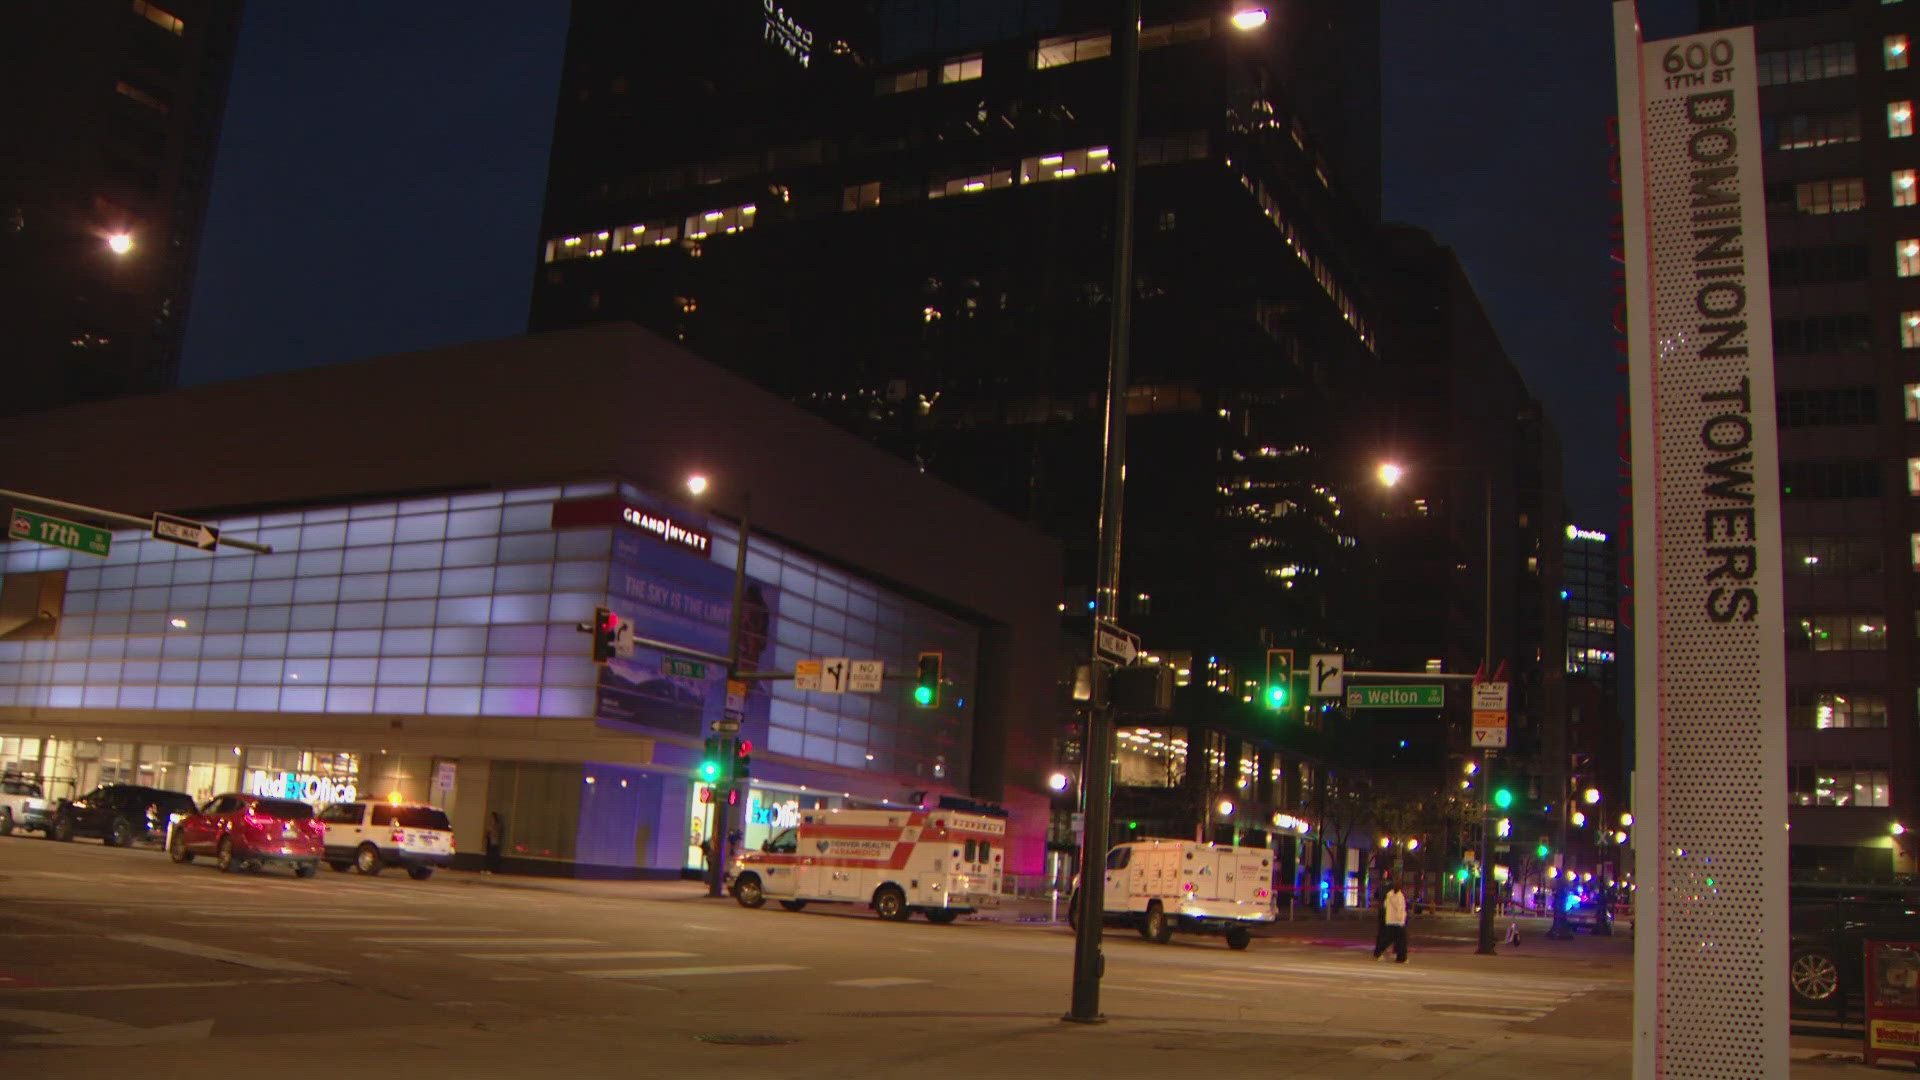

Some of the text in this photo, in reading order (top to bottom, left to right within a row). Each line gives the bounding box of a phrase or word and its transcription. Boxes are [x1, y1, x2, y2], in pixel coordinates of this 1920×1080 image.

[1663, 39, 1734, 73] 600
[1664, 67, 1735, 91] 17TH ST
[1687, 89, 1759, 623] DOMINION TOWERS
[40, 521, 80, 547] 17th
[160, 521, 199, 539] ONE WAY
[623, 507, 666, 535] GRAND
[669, 525, 707, 551] HYATT
[625, 575, 646, 599] THE
[649, 582, 668, 604] SKY
[860, 663, 874, 673] NO
[1368, 688, 1418, 704] Welton
[831, 840, 891, 849] DENVER HEALTH
